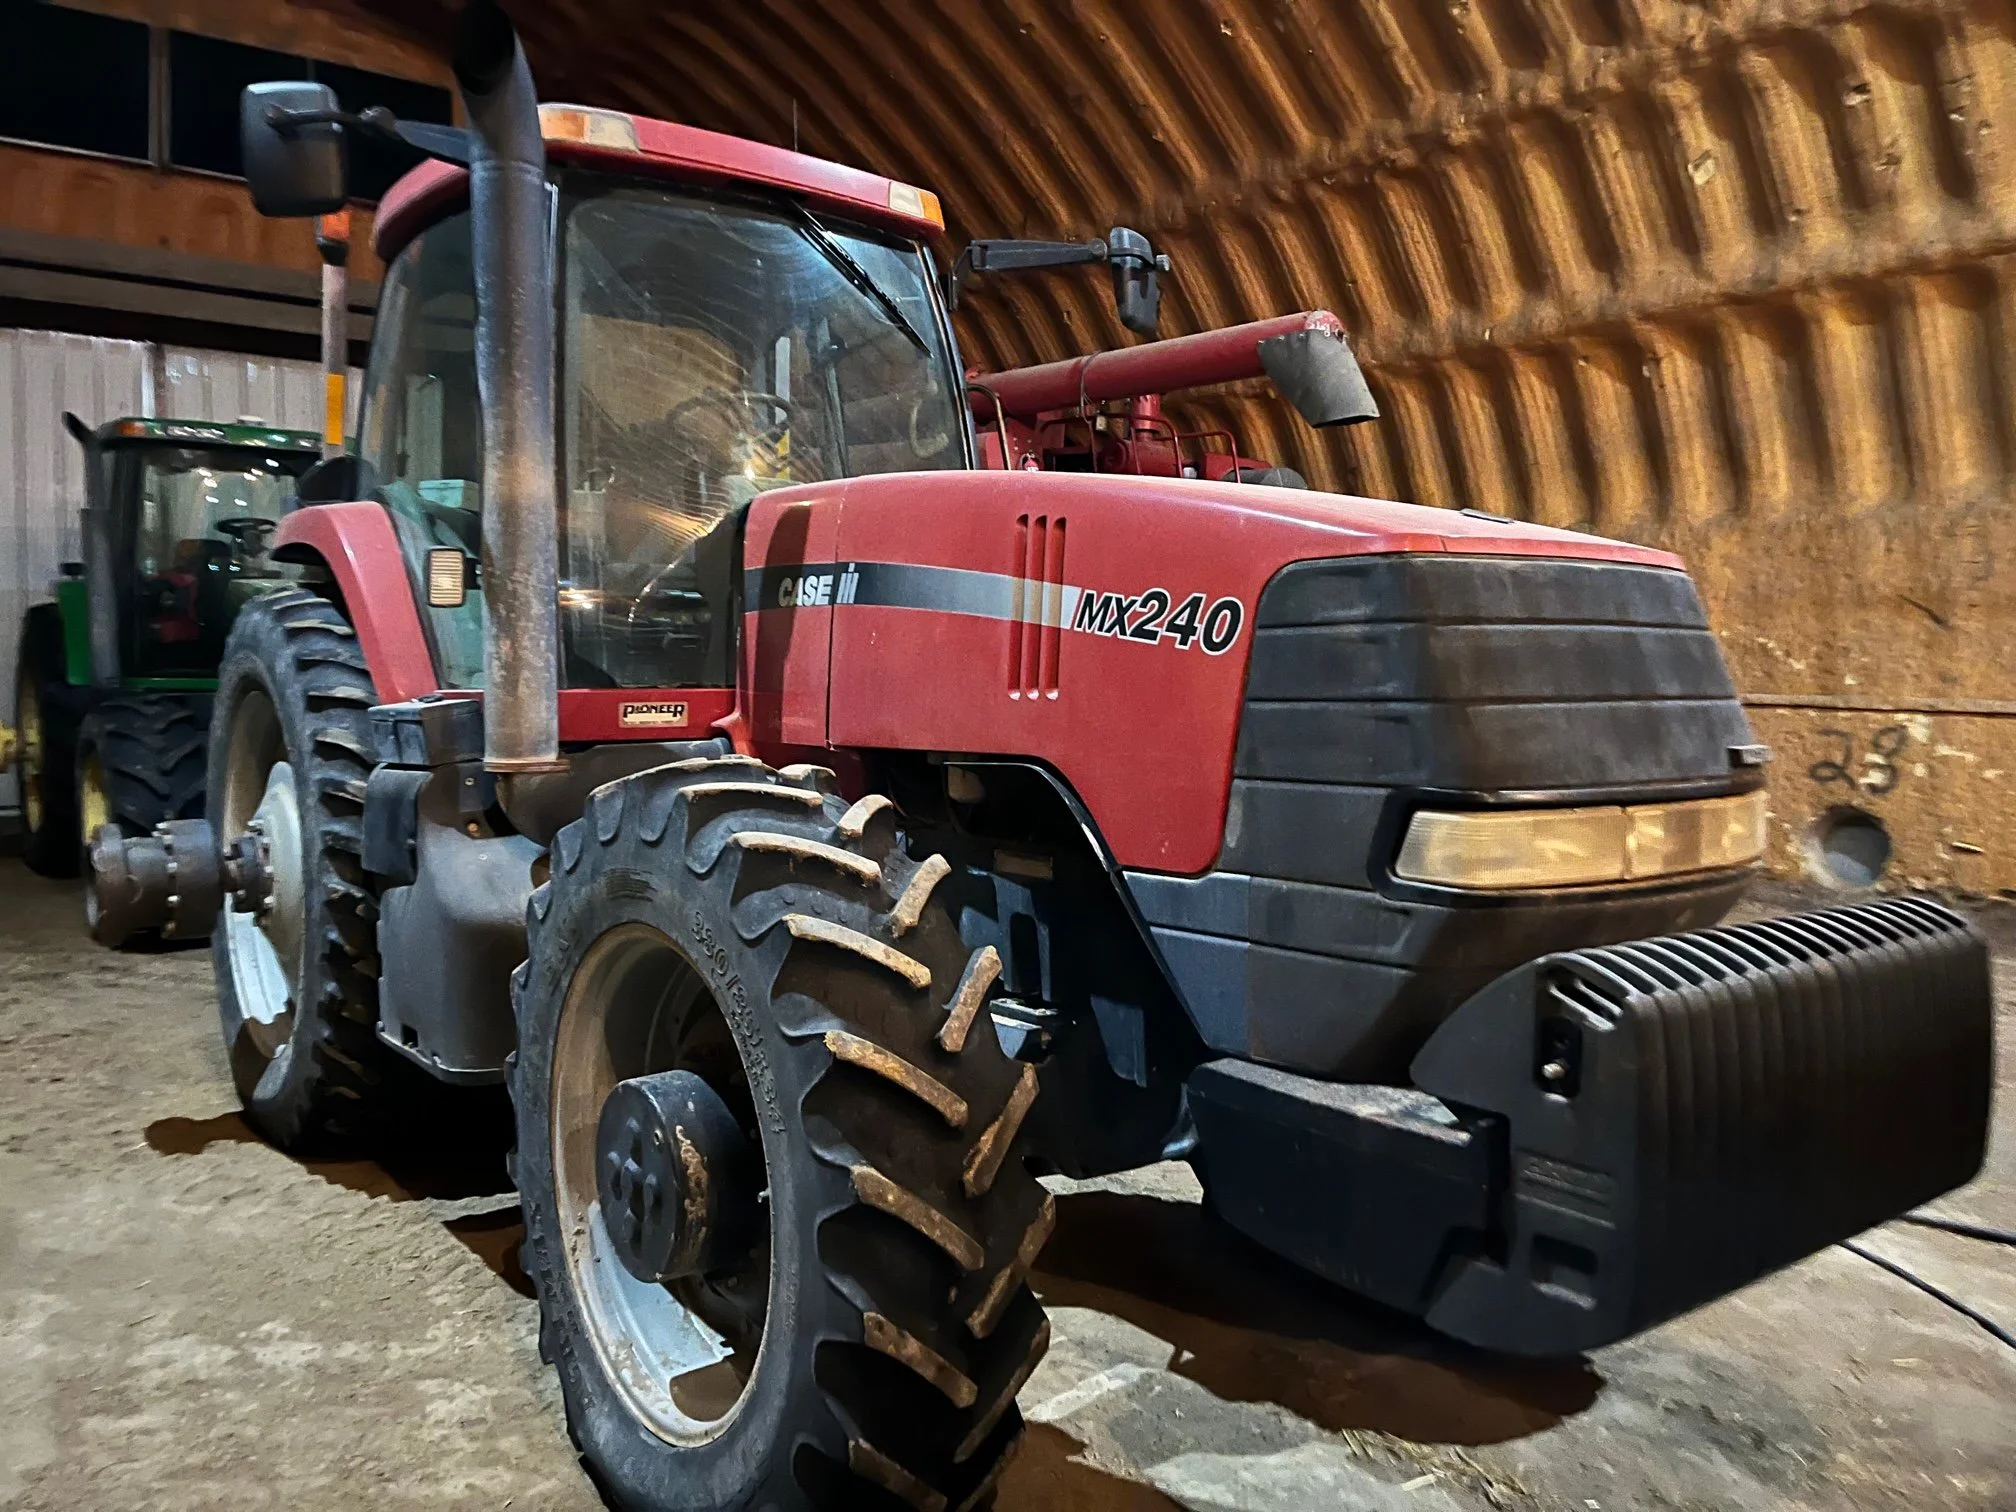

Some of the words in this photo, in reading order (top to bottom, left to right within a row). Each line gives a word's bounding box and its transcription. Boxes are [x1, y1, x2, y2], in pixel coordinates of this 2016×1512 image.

[778, 575, 834, 607] CASE
[1074, 587, 1244, 656] MX240
[623, 704, 685, 718] PIONEER
